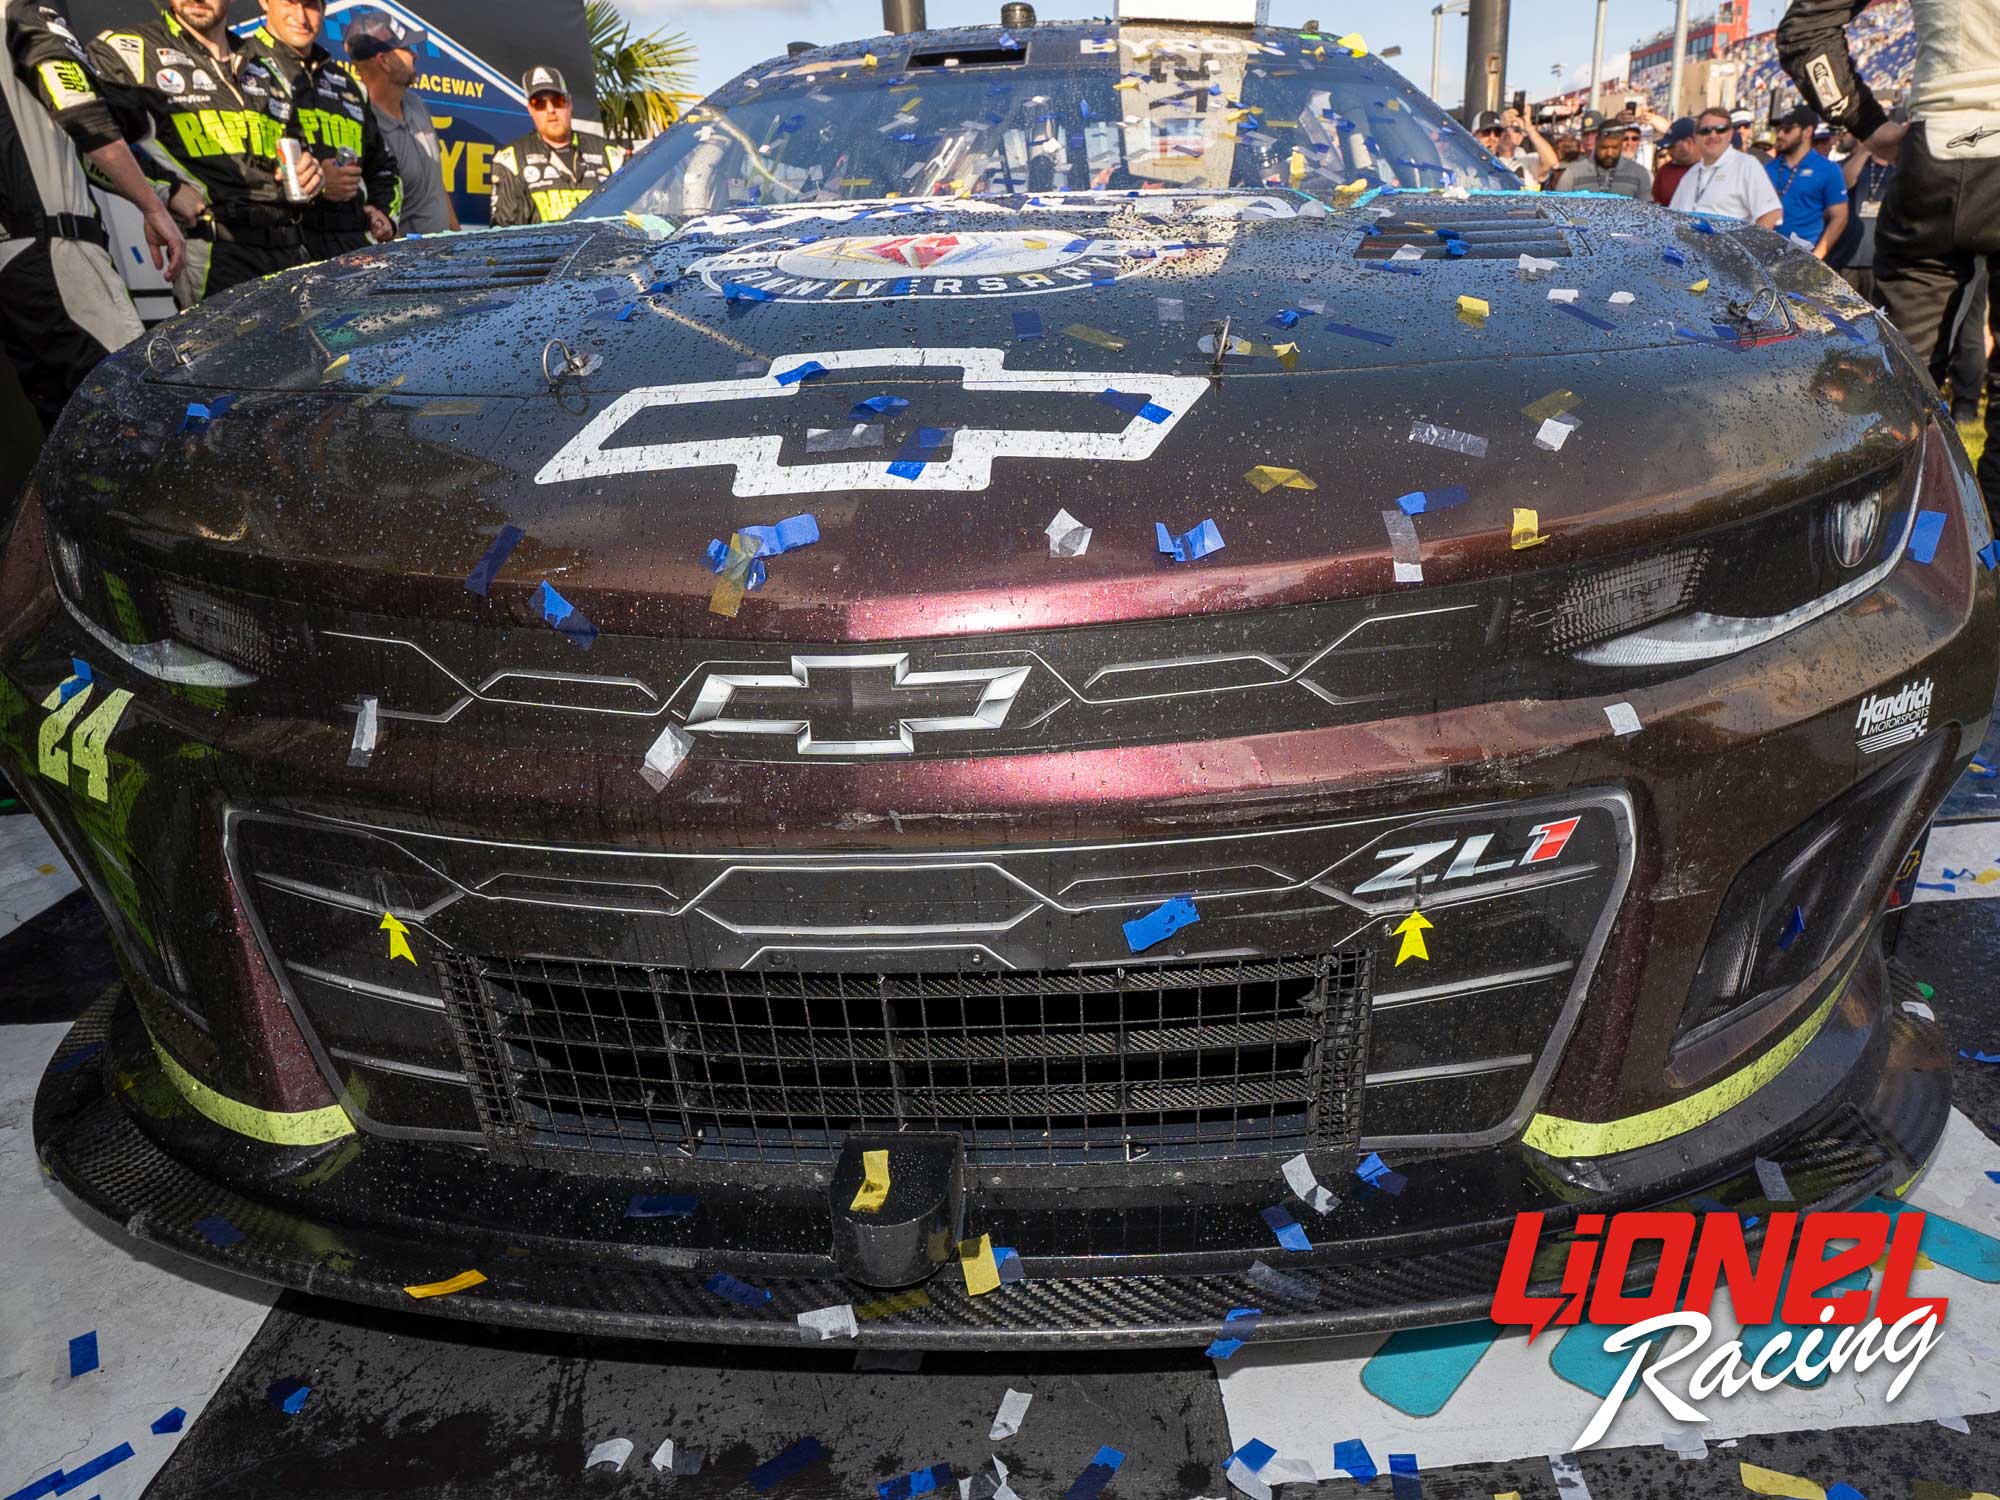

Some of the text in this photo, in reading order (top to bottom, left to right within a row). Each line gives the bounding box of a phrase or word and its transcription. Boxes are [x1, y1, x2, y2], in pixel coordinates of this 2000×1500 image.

[729, 257, 1121, 298] ANNIVERSARY
[1855, 677, 1935, 736] Hendrick
[1868, 706, 1930, 736] MOTORSPORTS
[39, 674, 135, 803] 24
[1353, 815, 1582, 894] ZL1
